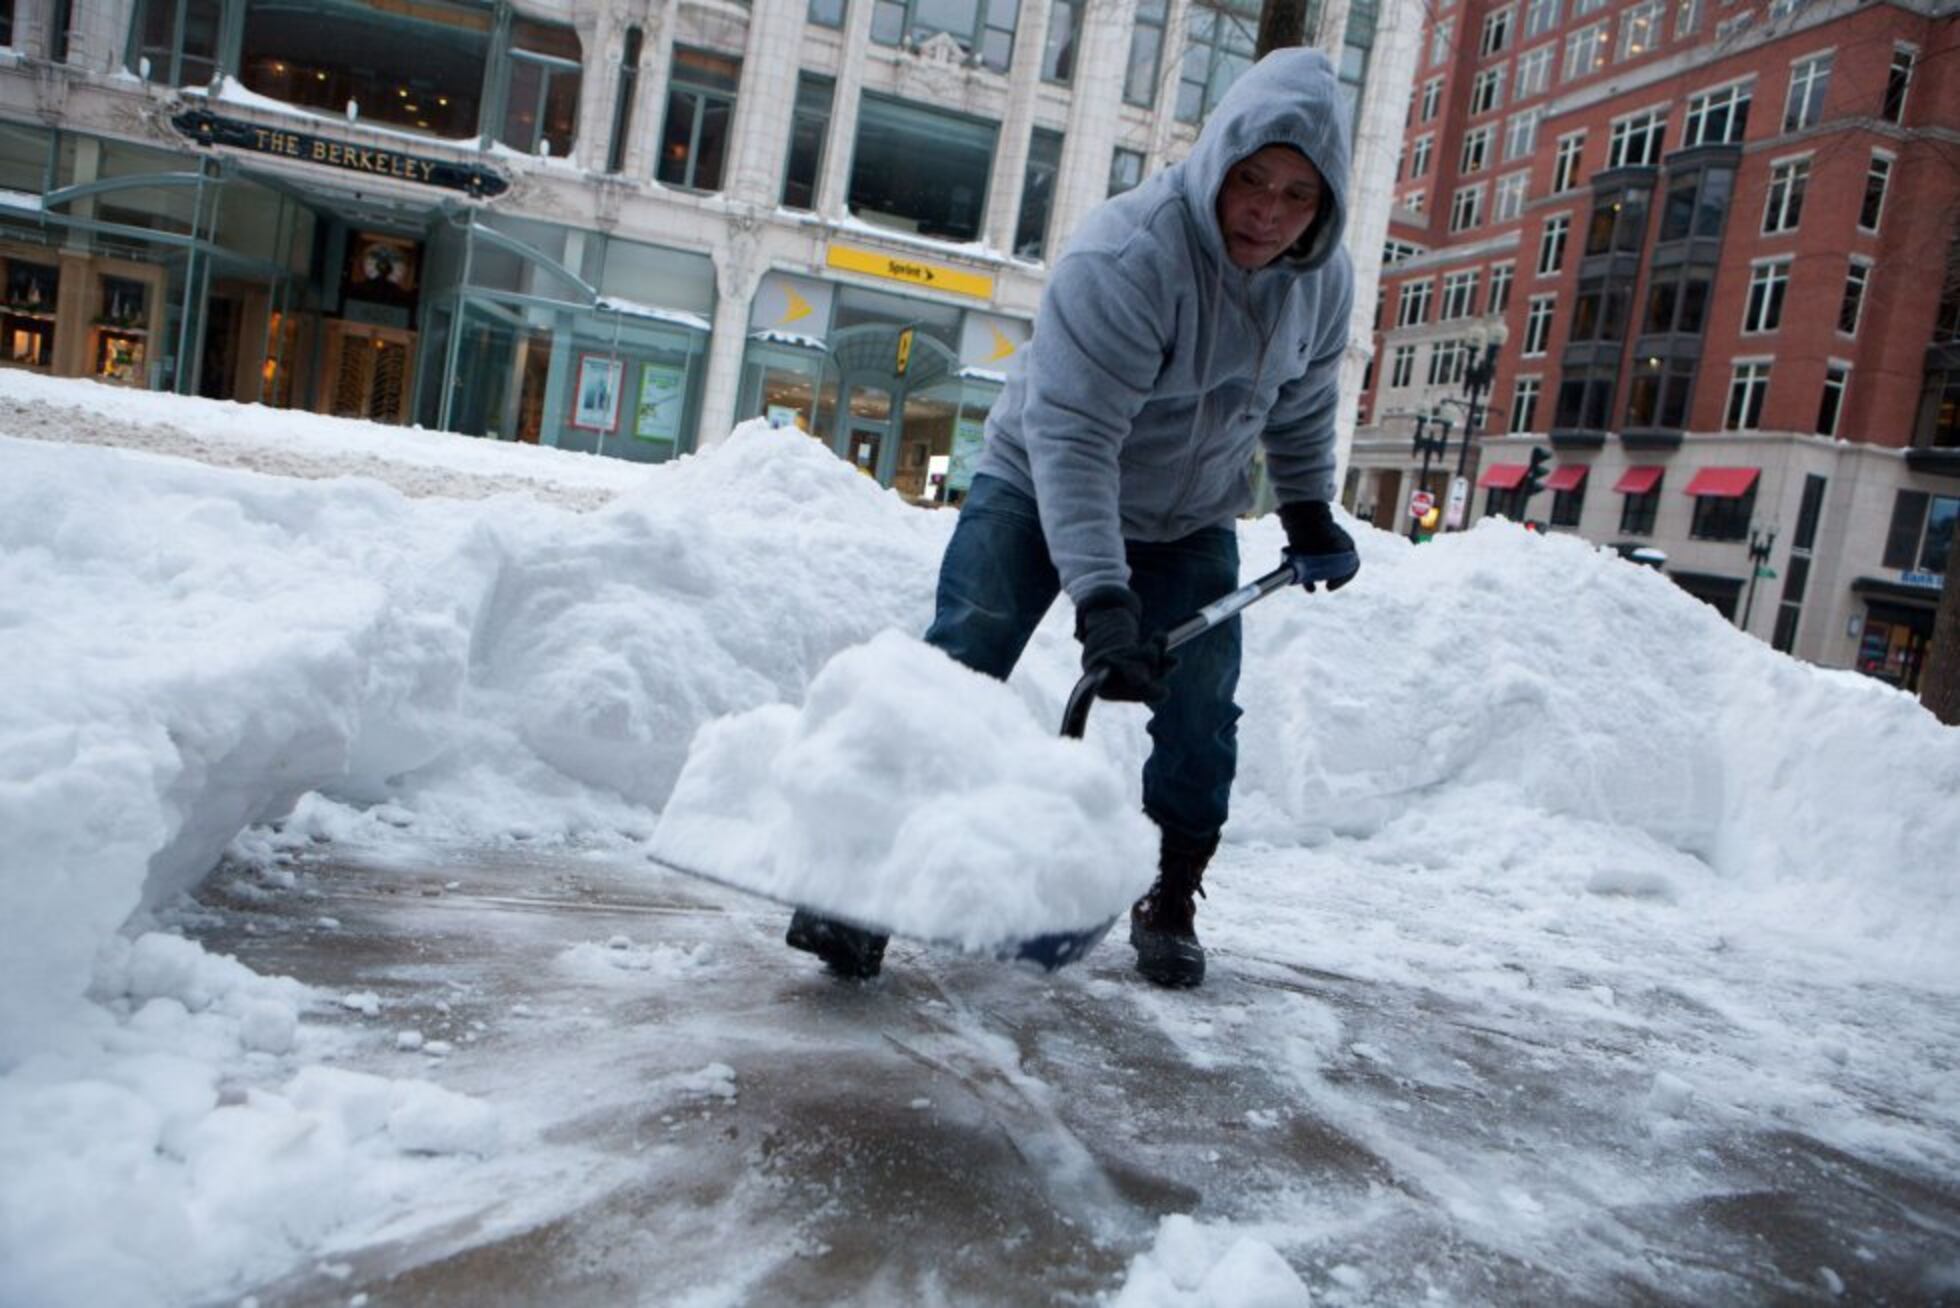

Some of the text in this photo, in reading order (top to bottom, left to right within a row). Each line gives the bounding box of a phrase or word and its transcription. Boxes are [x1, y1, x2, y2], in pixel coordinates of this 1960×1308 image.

[255, 129, 436, 181] THE BERKELEY
[888, 260, 921, 279] Sprint
